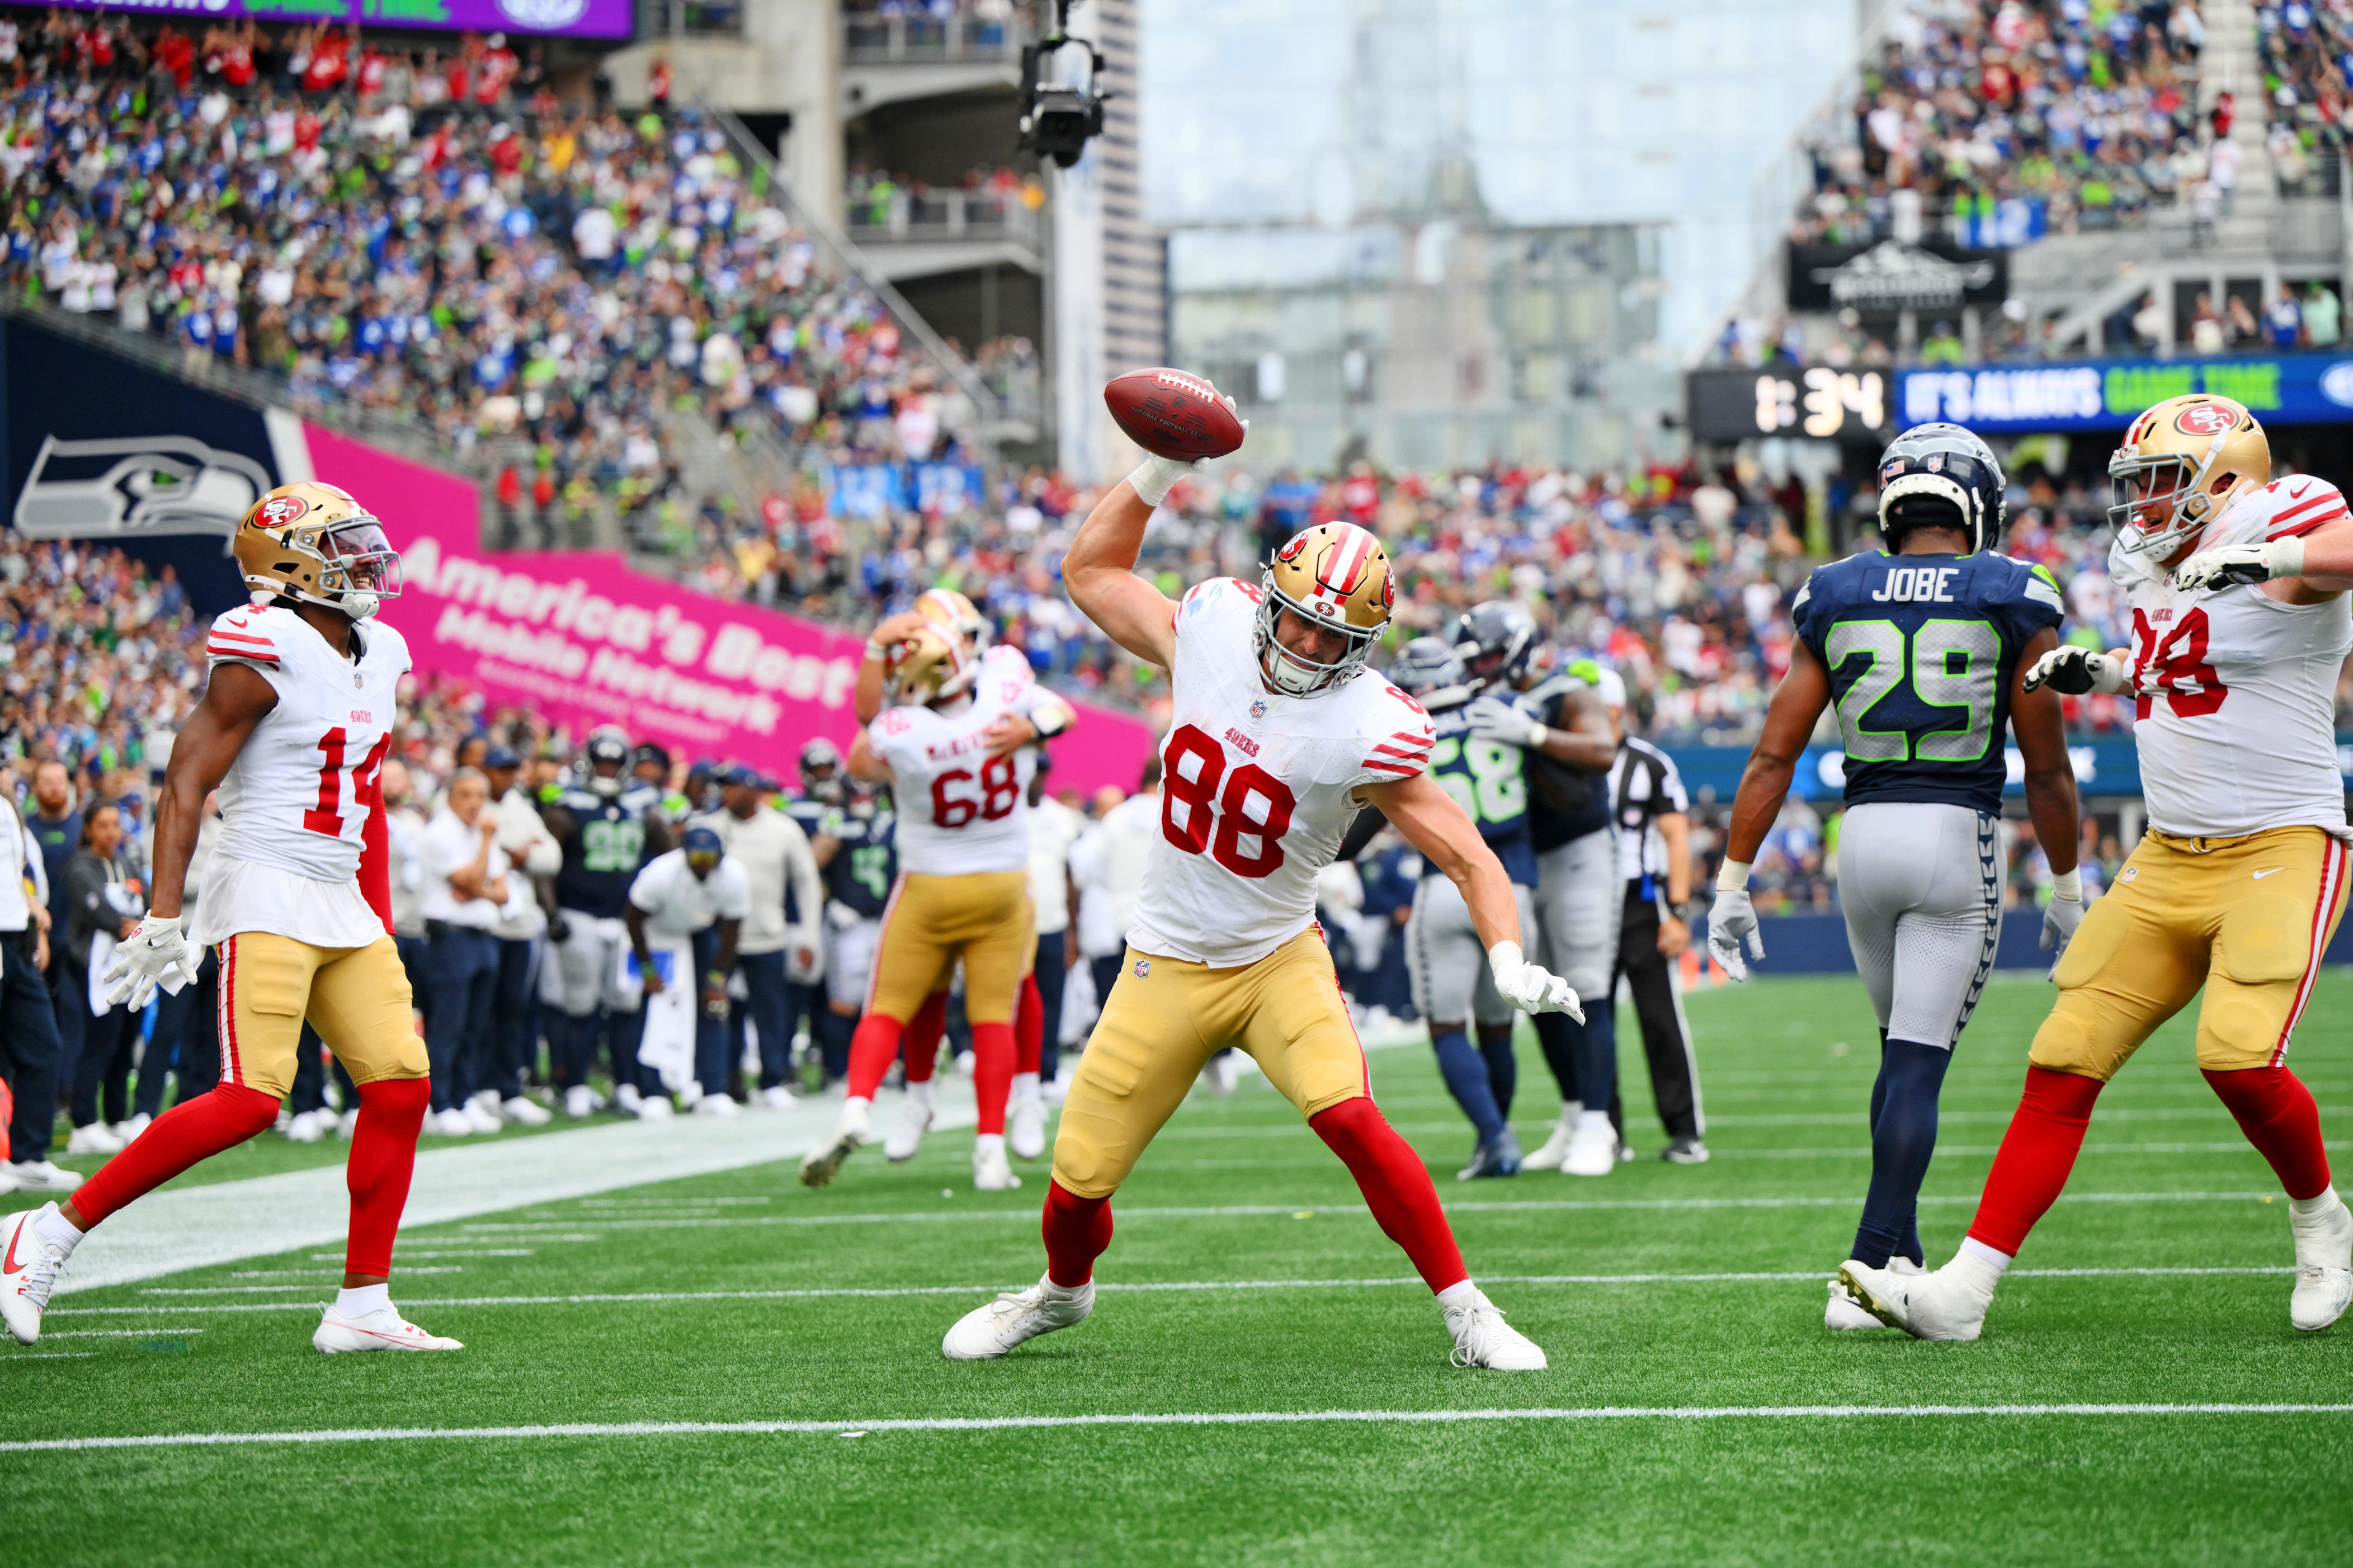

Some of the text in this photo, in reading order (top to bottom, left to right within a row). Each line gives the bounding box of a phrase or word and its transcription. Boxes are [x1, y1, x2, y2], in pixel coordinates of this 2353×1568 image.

[1131, 405, 1157, 421] NATIONAL
[1159, 418, 1189, 433] FOOTBALL
[1756, 367, 1884, 437] 1:34
[1872, 568, 1959, 602] JOBE
[389, 535, 856, 710] America's Best
[434, 603, 589, 679] Mobile
[588, 645, 782, 738] Network
[1825, 618, 2001, 762] 29
[1224, 727, 1260, 757] 49ERS
[930, 755, 1020, 829] 68
[1161, 723, 1297, 878] 88
